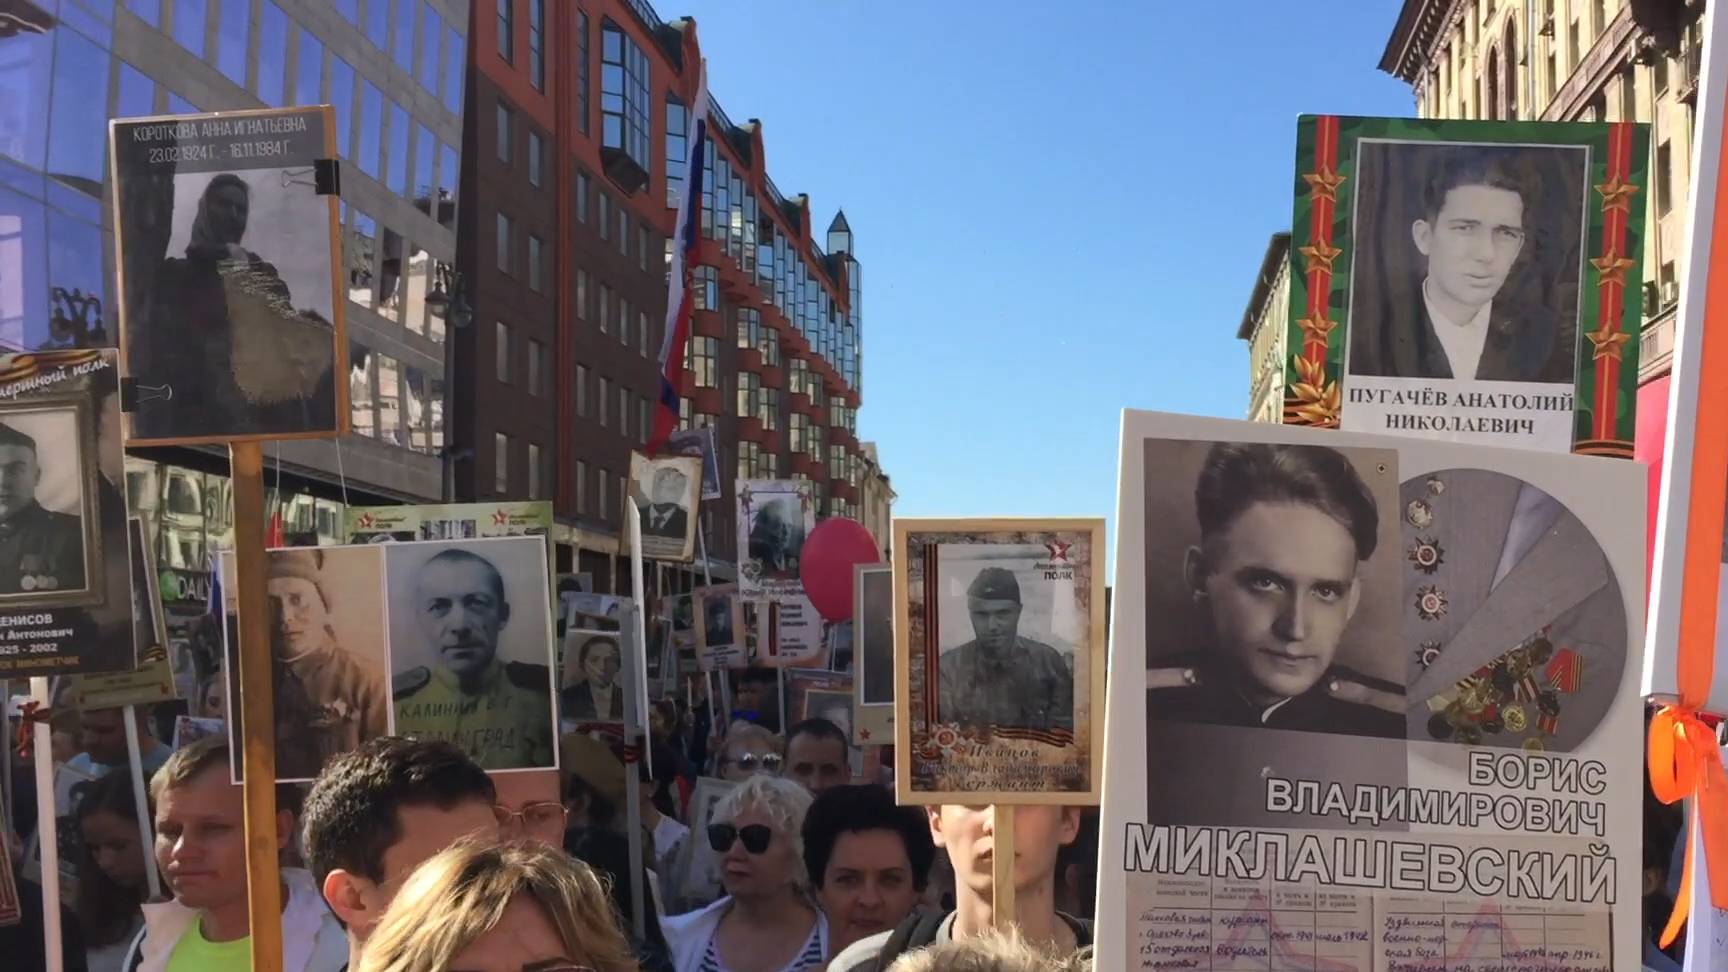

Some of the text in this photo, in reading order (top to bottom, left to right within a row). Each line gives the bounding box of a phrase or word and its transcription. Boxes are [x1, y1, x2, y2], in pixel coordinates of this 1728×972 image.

[133, 117, 307, 141] КОРОТКОВА АННА ИГНАТЬЕВНА
[150, 144, 207, 163] 23.02.1924
[1350, 386, 1574, 412] ПУГАЧЁВ АНАТОЛИЙ
[1385, 413, 1535, 435] НИКОЛАЕВИЧ
[7, 628, 73, 640] Антонович
[30, 643, 58, 653] 2002
[1469, 751, 1606, 795] БОРИС
[1266, 777, 1606, 837] ВЛАДИМИРОВИЧ
[1124, 822, 1617, 904] МИКЛАШЕВСКИЙ
